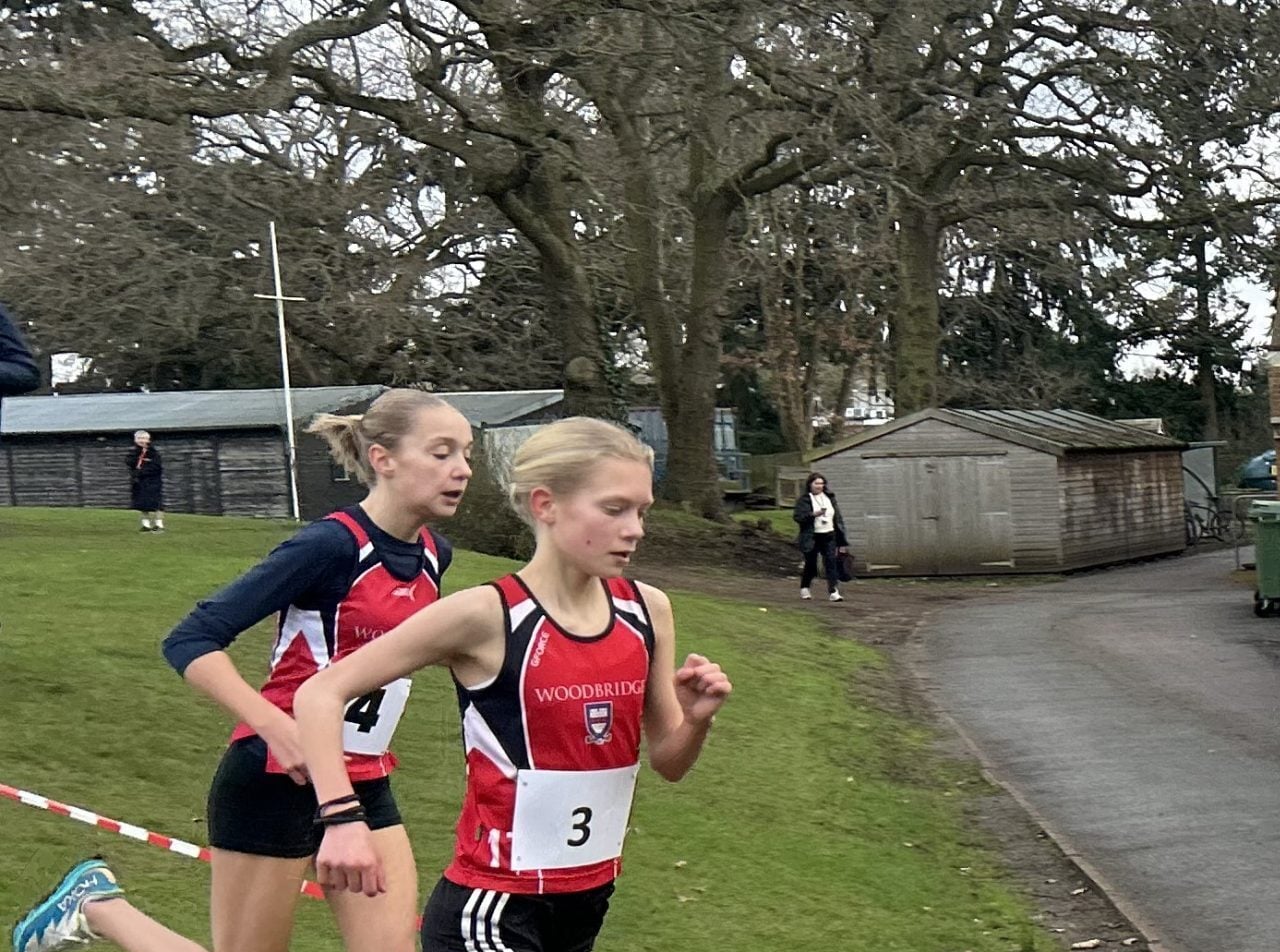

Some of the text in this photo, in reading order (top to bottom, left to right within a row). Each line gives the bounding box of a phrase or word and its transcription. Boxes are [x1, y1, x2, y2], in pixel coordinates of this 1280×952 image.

[531, 631, 550, 668] GFORCE
[344, 687, 387, 734] 4
[566, 806, 593, 847] 3
